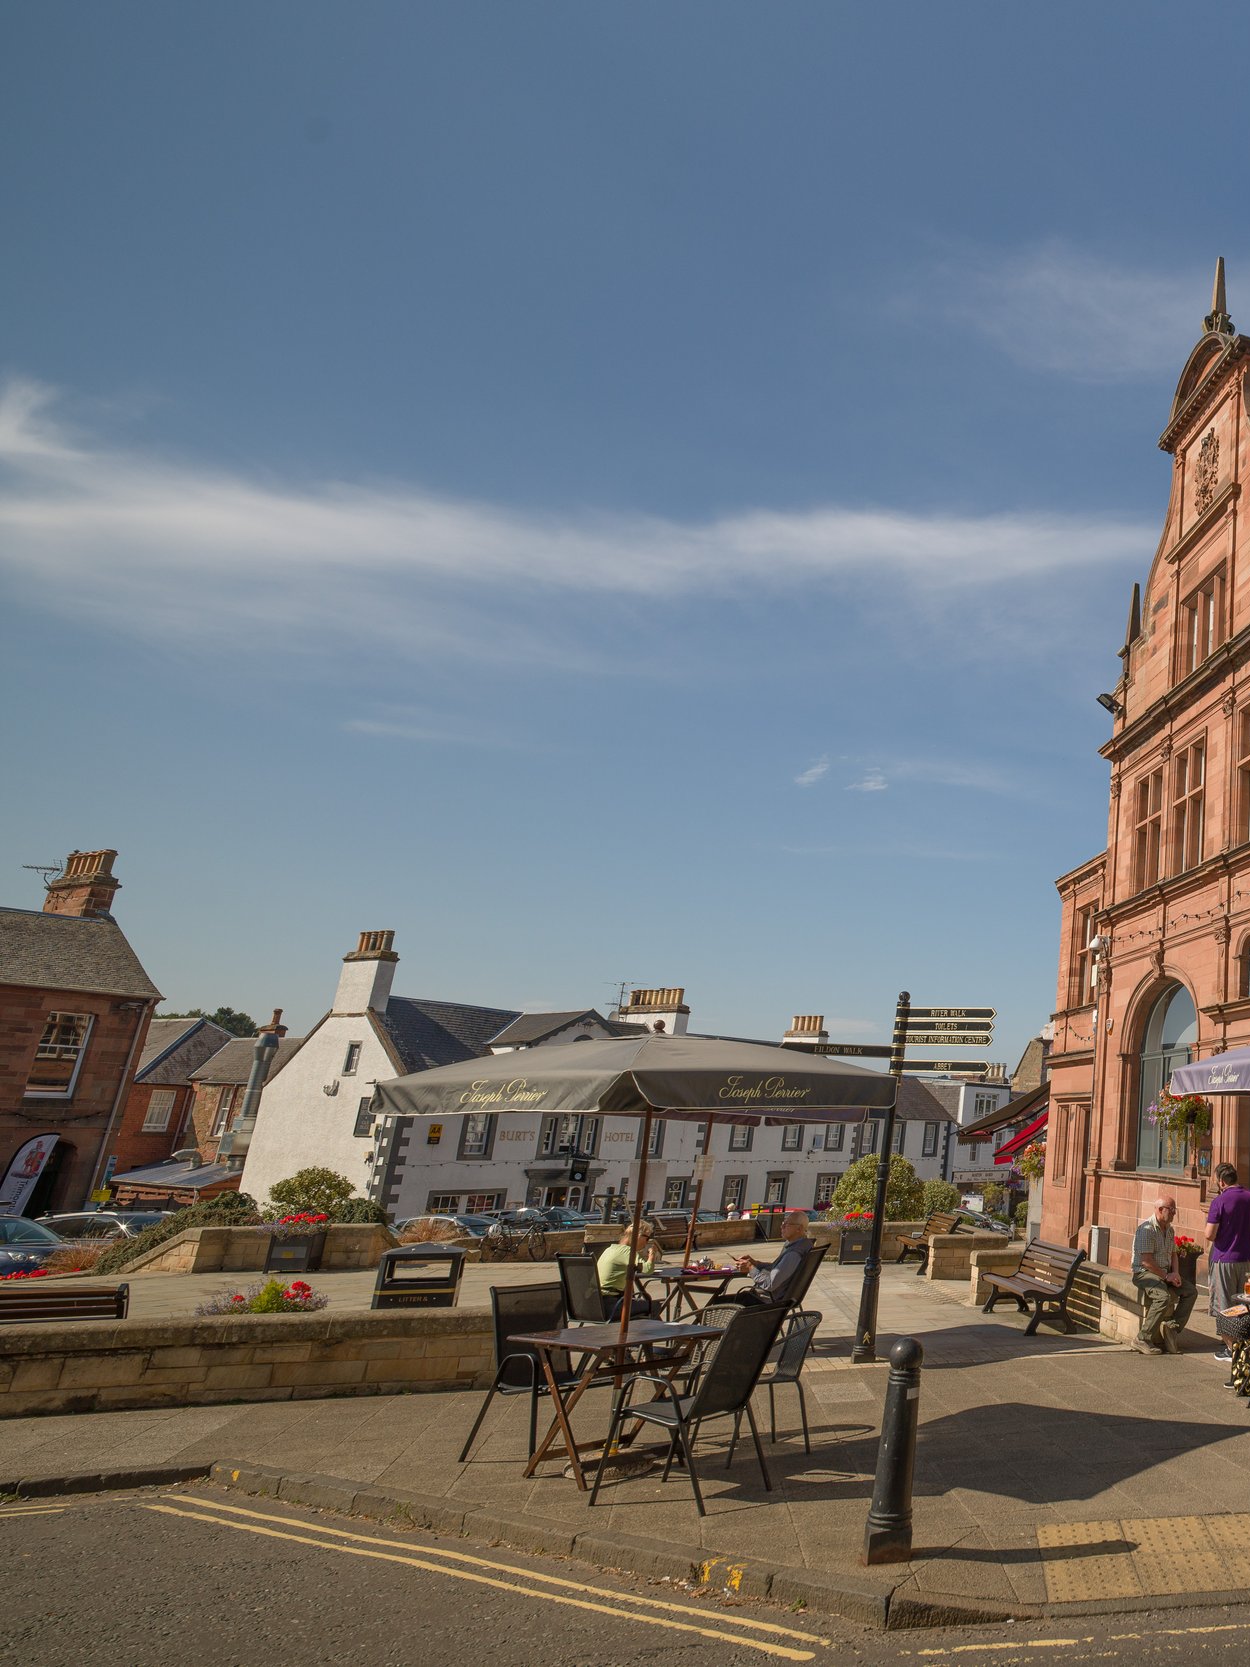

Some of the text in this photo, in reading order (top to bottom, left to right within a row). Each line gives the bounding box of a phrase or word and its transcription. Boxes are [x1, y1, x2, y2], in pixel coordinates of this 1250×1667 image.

[930, 1009, 966, 1017] RIVER WALK
[906, 1035, 927, 1043] TOURIST
[928, 1035, 963, 1043] INFORMATION
[814, 1045, 863, 1055] EILDON WALK
[933, 1062, 952, 1070] ABBEY
[460, 1079, 549, 1109] Joseph Perrier
[719, 1075, 811, 1104] Joseph Perrier
[499, 1131, 635, 1142] BURT'S HOTEL
